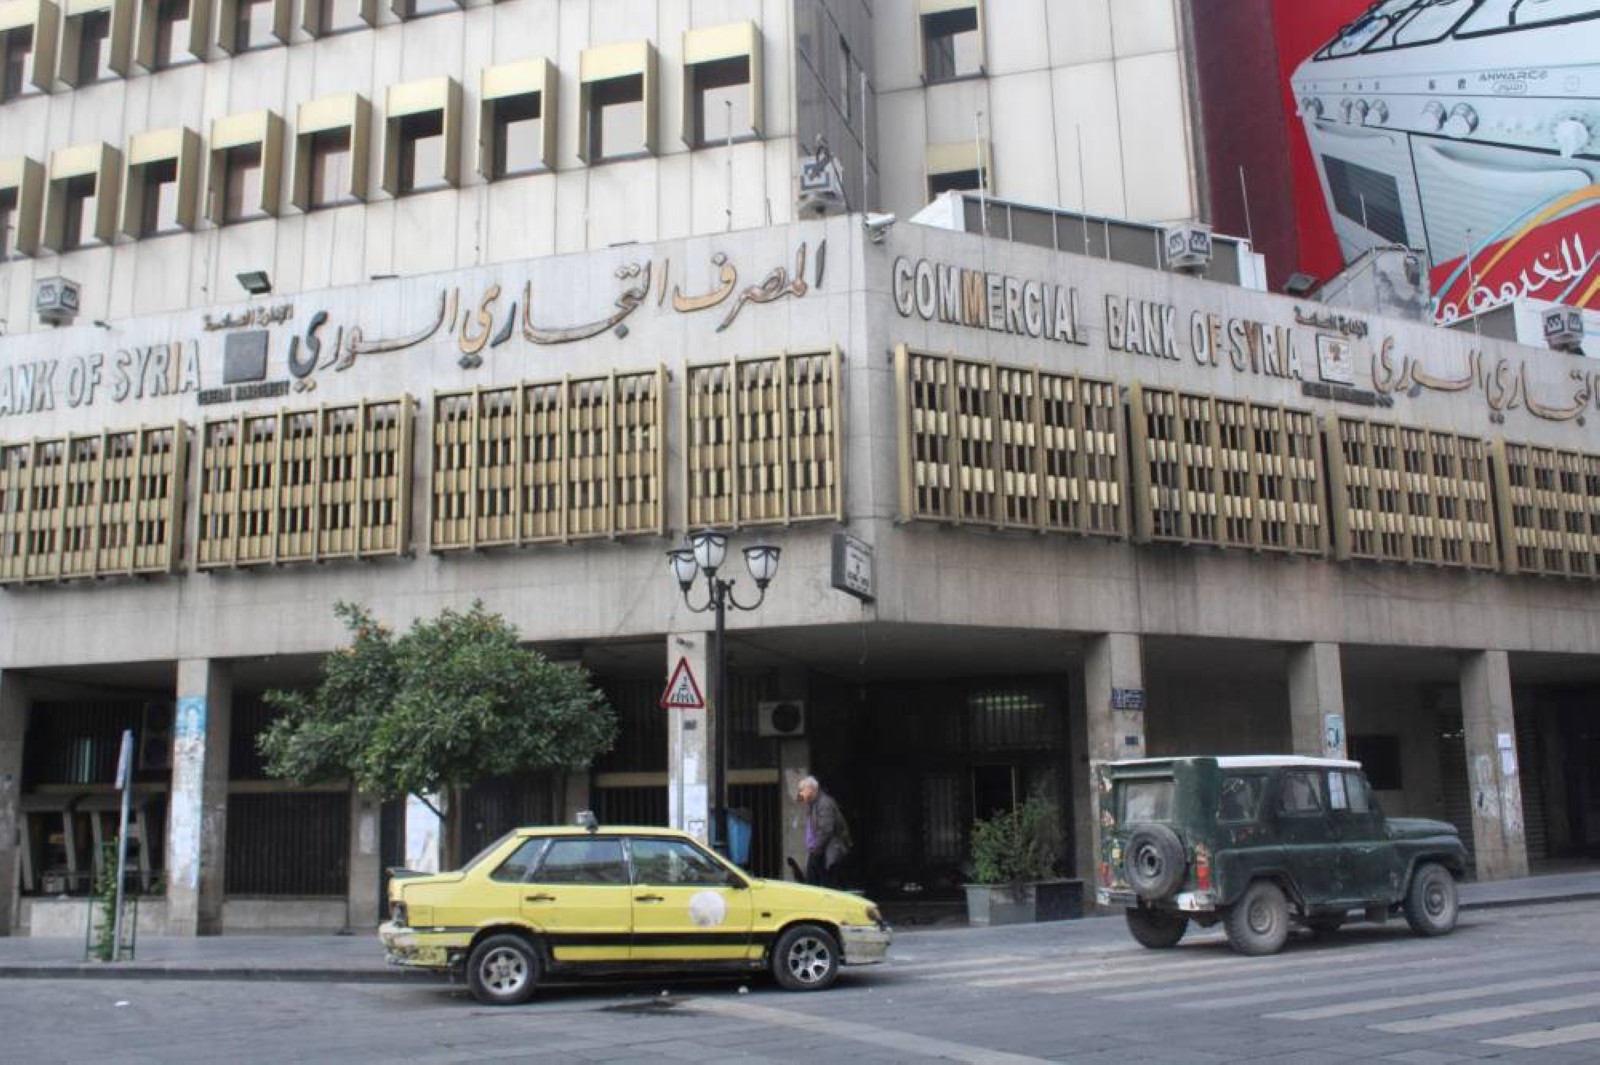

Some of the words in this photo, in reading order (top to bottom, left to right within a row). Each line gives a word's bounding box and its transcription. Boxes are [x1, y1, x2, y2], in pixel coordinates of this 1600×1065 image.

[457, 257, 670, 370] التجاري
[673, 237, 826, 333] المصرف
[893, 256, 1089, 346] COMMERCIAL
[1106, 294, 1181, 361] BANK
[1190, 310, 1222, 367] OF
[1228, 318, 1303, 381] SYRIA
[0, 358, 59, 417] ANK
[65, 353, 104, 408] OF
[114, 338, 201, 402] SYRIA
[288, 286, 459, 393] السوري
